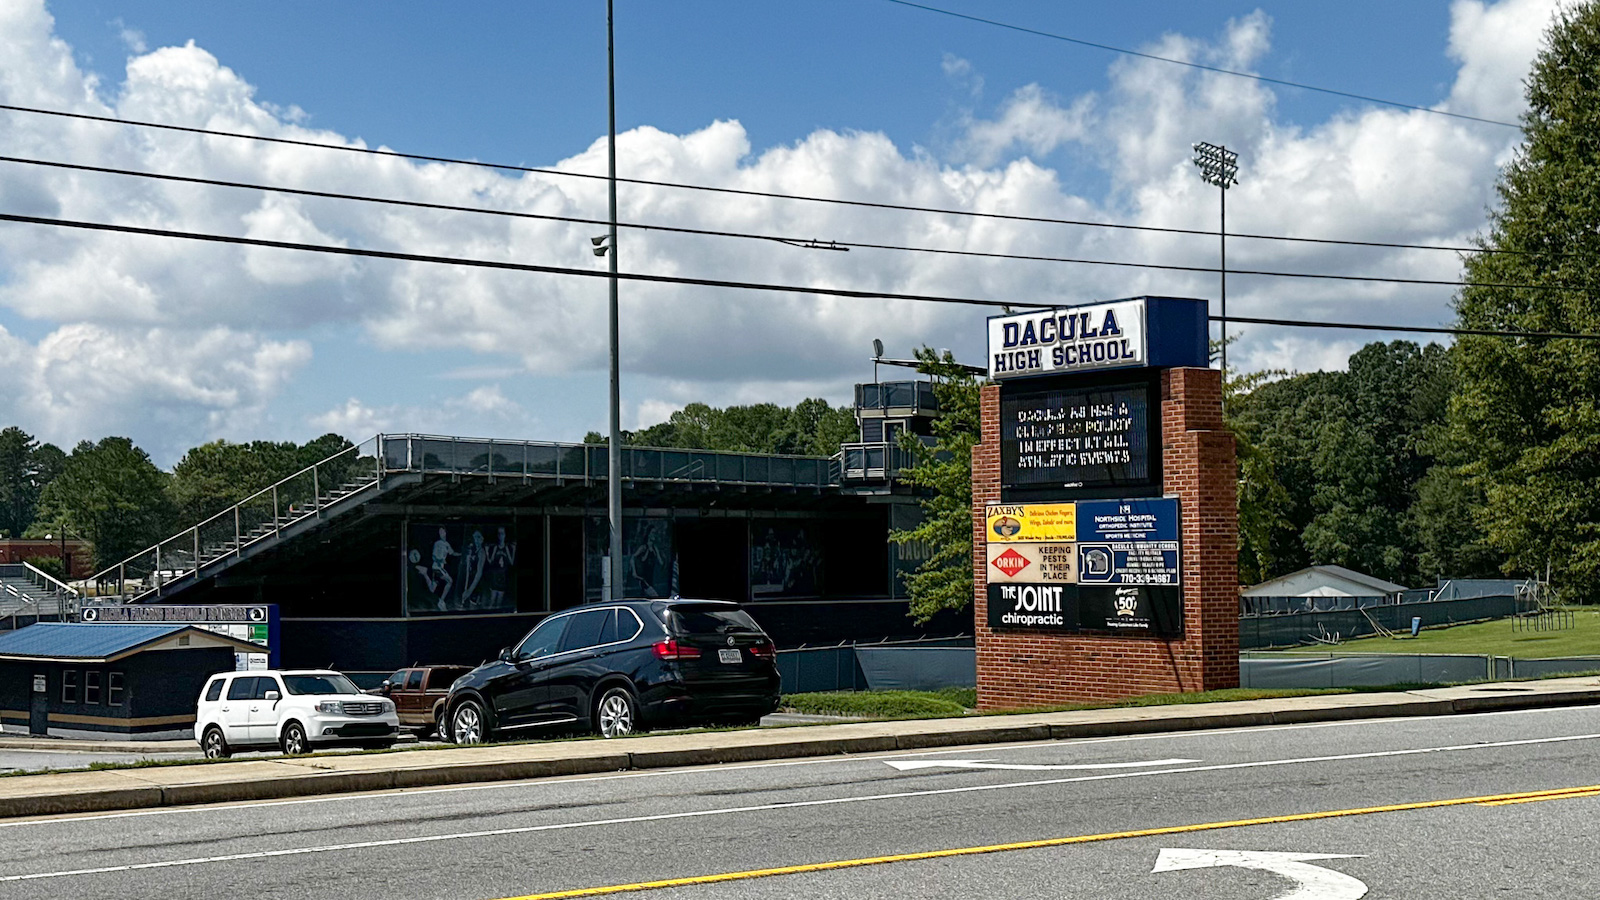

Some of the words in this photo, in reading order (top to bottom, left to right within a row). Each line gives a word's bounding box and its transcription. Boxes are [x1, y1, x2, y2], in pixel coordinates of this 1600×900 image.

[1002, 309, 1121, 348] DACULA
[994, 349, 1041, 372] HIGH
[1052, 339, 1134, 366] SCHOOL
[1119, 402, 1128, 415] A
[1085, 418, 1132, 432] POLICY
[1019, 441, 1033, 453] IN
[1035, 438, 1081, 452] EFFECT
[1104, 434, 1128, 448] ALL
[1018, 453, 1077, 468] ATHLETIC
[1080, 450, 1130, 466] EVENTS
[987, 505, 1025, 518] ZAXBY'S
[1094, 515, 1127, 523] NORTHSIDE
[1128, 514, 1157, 522] HOSPITAL
[1038, 546, 1071, 554] KEEPING
[996, 557, 1025, 568] ORKIN
[1042, 572, 1068, 580] PLACE
[1001, 586, 1016, 599] THE
[1015, 585, 1063, 612] JOINT
[99, 607, 129, 620] DACULA
[130, 607, 164, 620] FALCONS
[208, 607, 247, 620] SPONSORS
[1001, 612, 1064, 626] chiropractic
